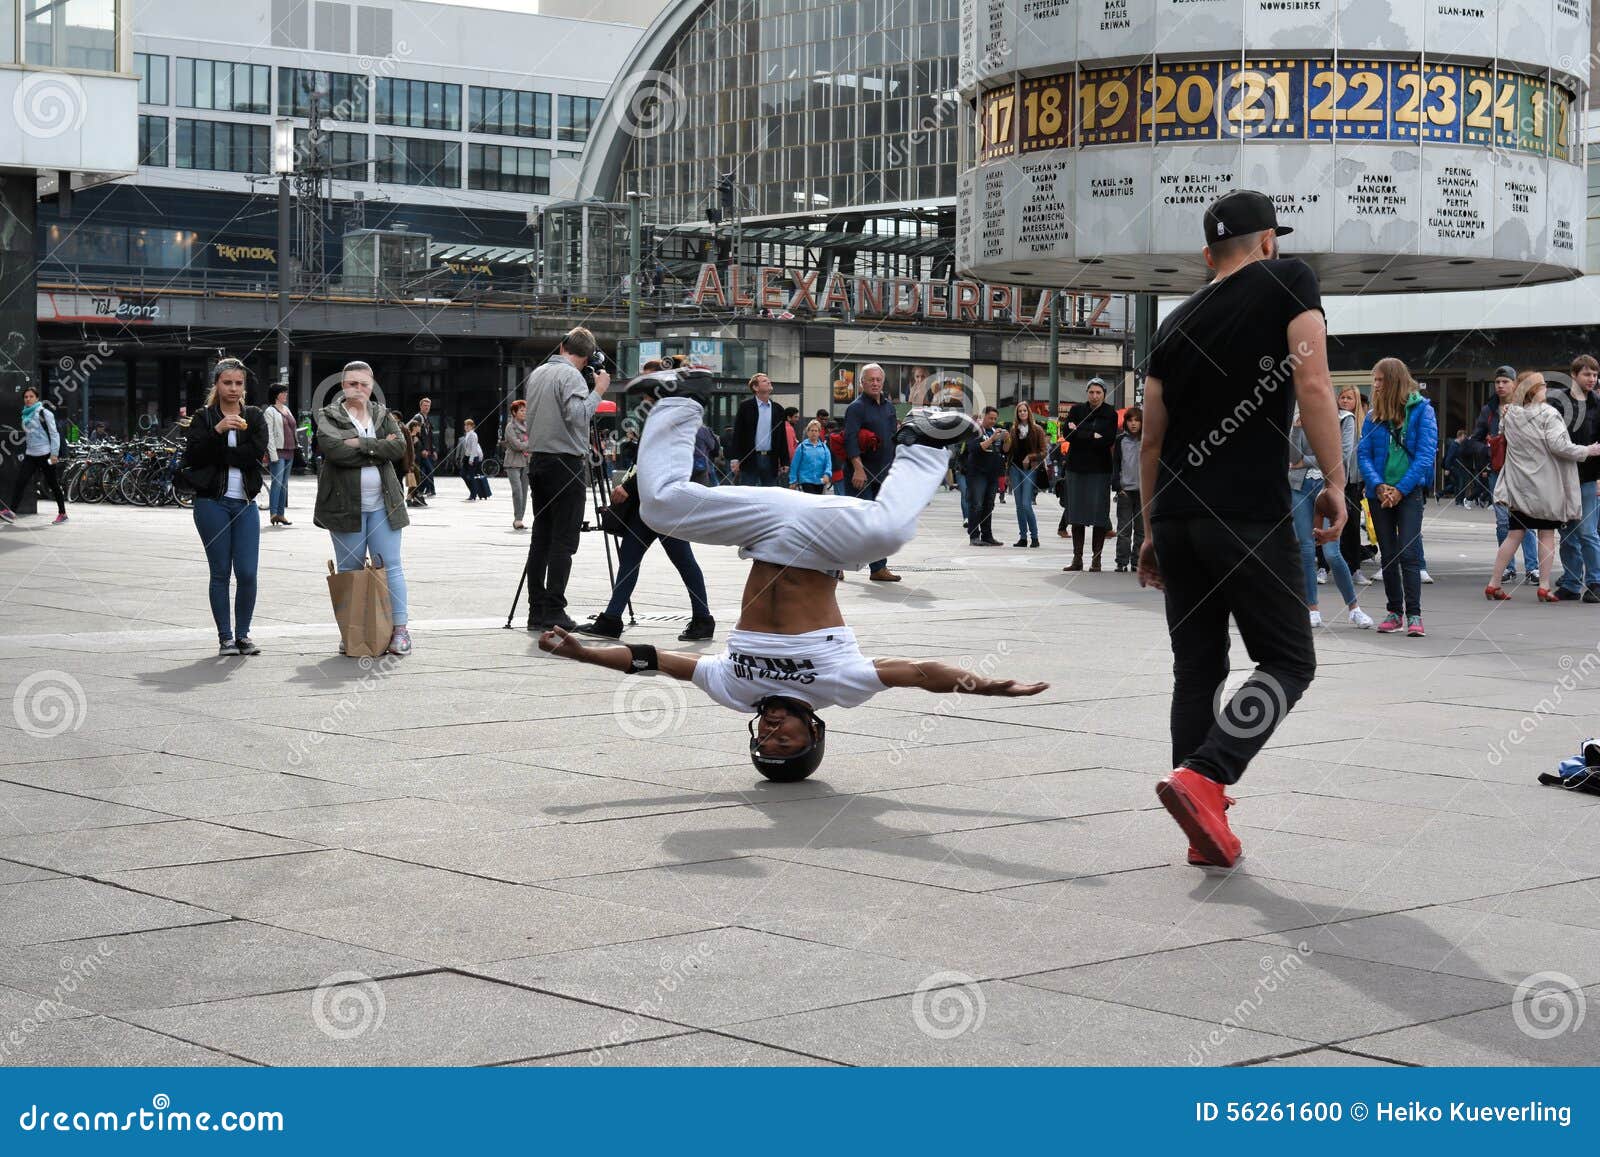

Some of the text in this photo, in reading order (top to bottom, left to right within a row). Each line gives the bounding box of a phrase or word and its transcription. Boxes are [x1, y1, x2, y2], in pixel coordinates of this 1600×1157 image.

[1105, 0, 1126, 9] BAKU
[1260, 1, 1321, 11] NOWOSIBIRSK
[1438, 6, 1485, 18] ULAN-BATOR
[1100, 20, 1130, 30] ERIWAN
[989, 95, 1014, 144] 17
[1024, 88, 1062, 137] 18
[1080, 80, 1129, 130] 19
[1141, 75, 1214, 124] 20
[1228, 71, 1290, 121] 21
[1310, 71, 1384, 121] 22
[1396, 74, 1457, 125] 23
[1467, 79, 1515, 131] 24
[1532, 90, 1544, 138] 1
[1022, 163, 1052, 174] TEHERAN
[1445, 167, 1472, 177] PEKING
[1032, 174, 1057, 183] BAGDAD
[1091, 178, 1116, 188] KABUL
[1160, 175, 1179, 184] NEW
[1184, 175, 1211, 183] DELHI
[1363, 175, 1392, 183] HANOI
[1437, 177, 1479, 187] SHANGHAI
[1036, 184, 1053, 192] ADEN
[1092, 187, 1134, 197] MAURITIUS
[1175, 185, 1218, 193] KARACHI
[1357, 185, 1398, 194] BANGKOK
[1442, 188, 1472, 197] MANILA
[1032, 193, 1055, 202] SANAA
[1164, 195, 1205, 204] COLOMBO
[1268, 194, 1295, 203] NGUN
[1347, 195, 1406, 204] PHNOM PENH
[1446, 199, 1469, 208] PERTH
[1512, 203, 1529, 213] SEOUL
[1023, 204, 1042, 213] ADDIS
[1276, 205, 1304, 214] HAKA
[1356, 206, 1397, 215] JAKARTA
[1436, 208, 1478, 218] HONGKONG
[1428, 218, 1485, 230] KUALA LUMPUR
[1438, 229, 1475, 239] SINGAPUR
[695, 263, 1112, 329] ALEXANDERPLATZ
